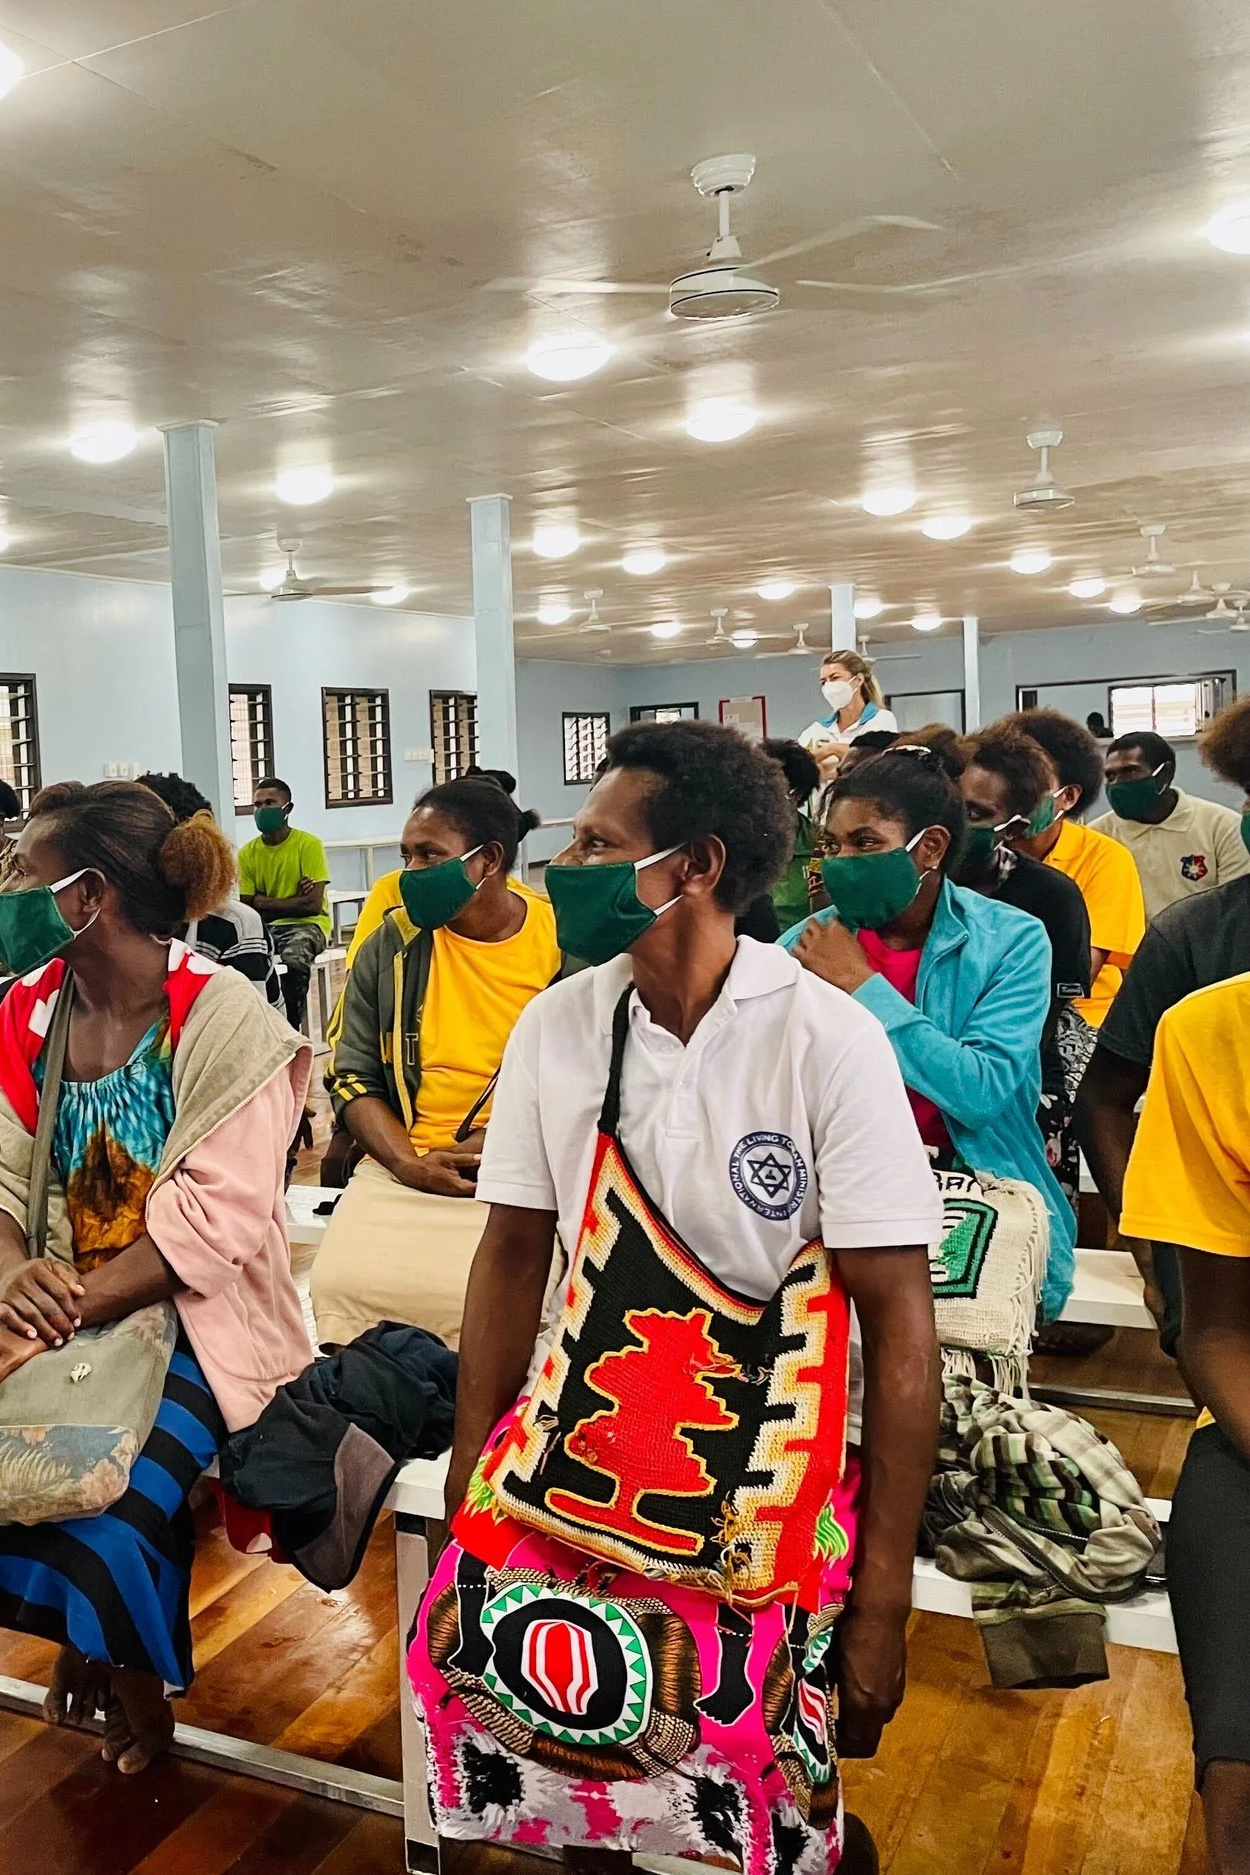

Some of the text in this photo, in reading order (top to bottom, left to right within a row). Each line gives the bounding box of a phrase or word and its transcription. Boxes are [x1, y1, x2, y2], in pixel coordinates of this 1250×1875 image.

[733, 1140, 747, 1158] THE
[746, 1134, 779, 1145] LIVING
[789, 1168, 807, 1214] MINISTR
